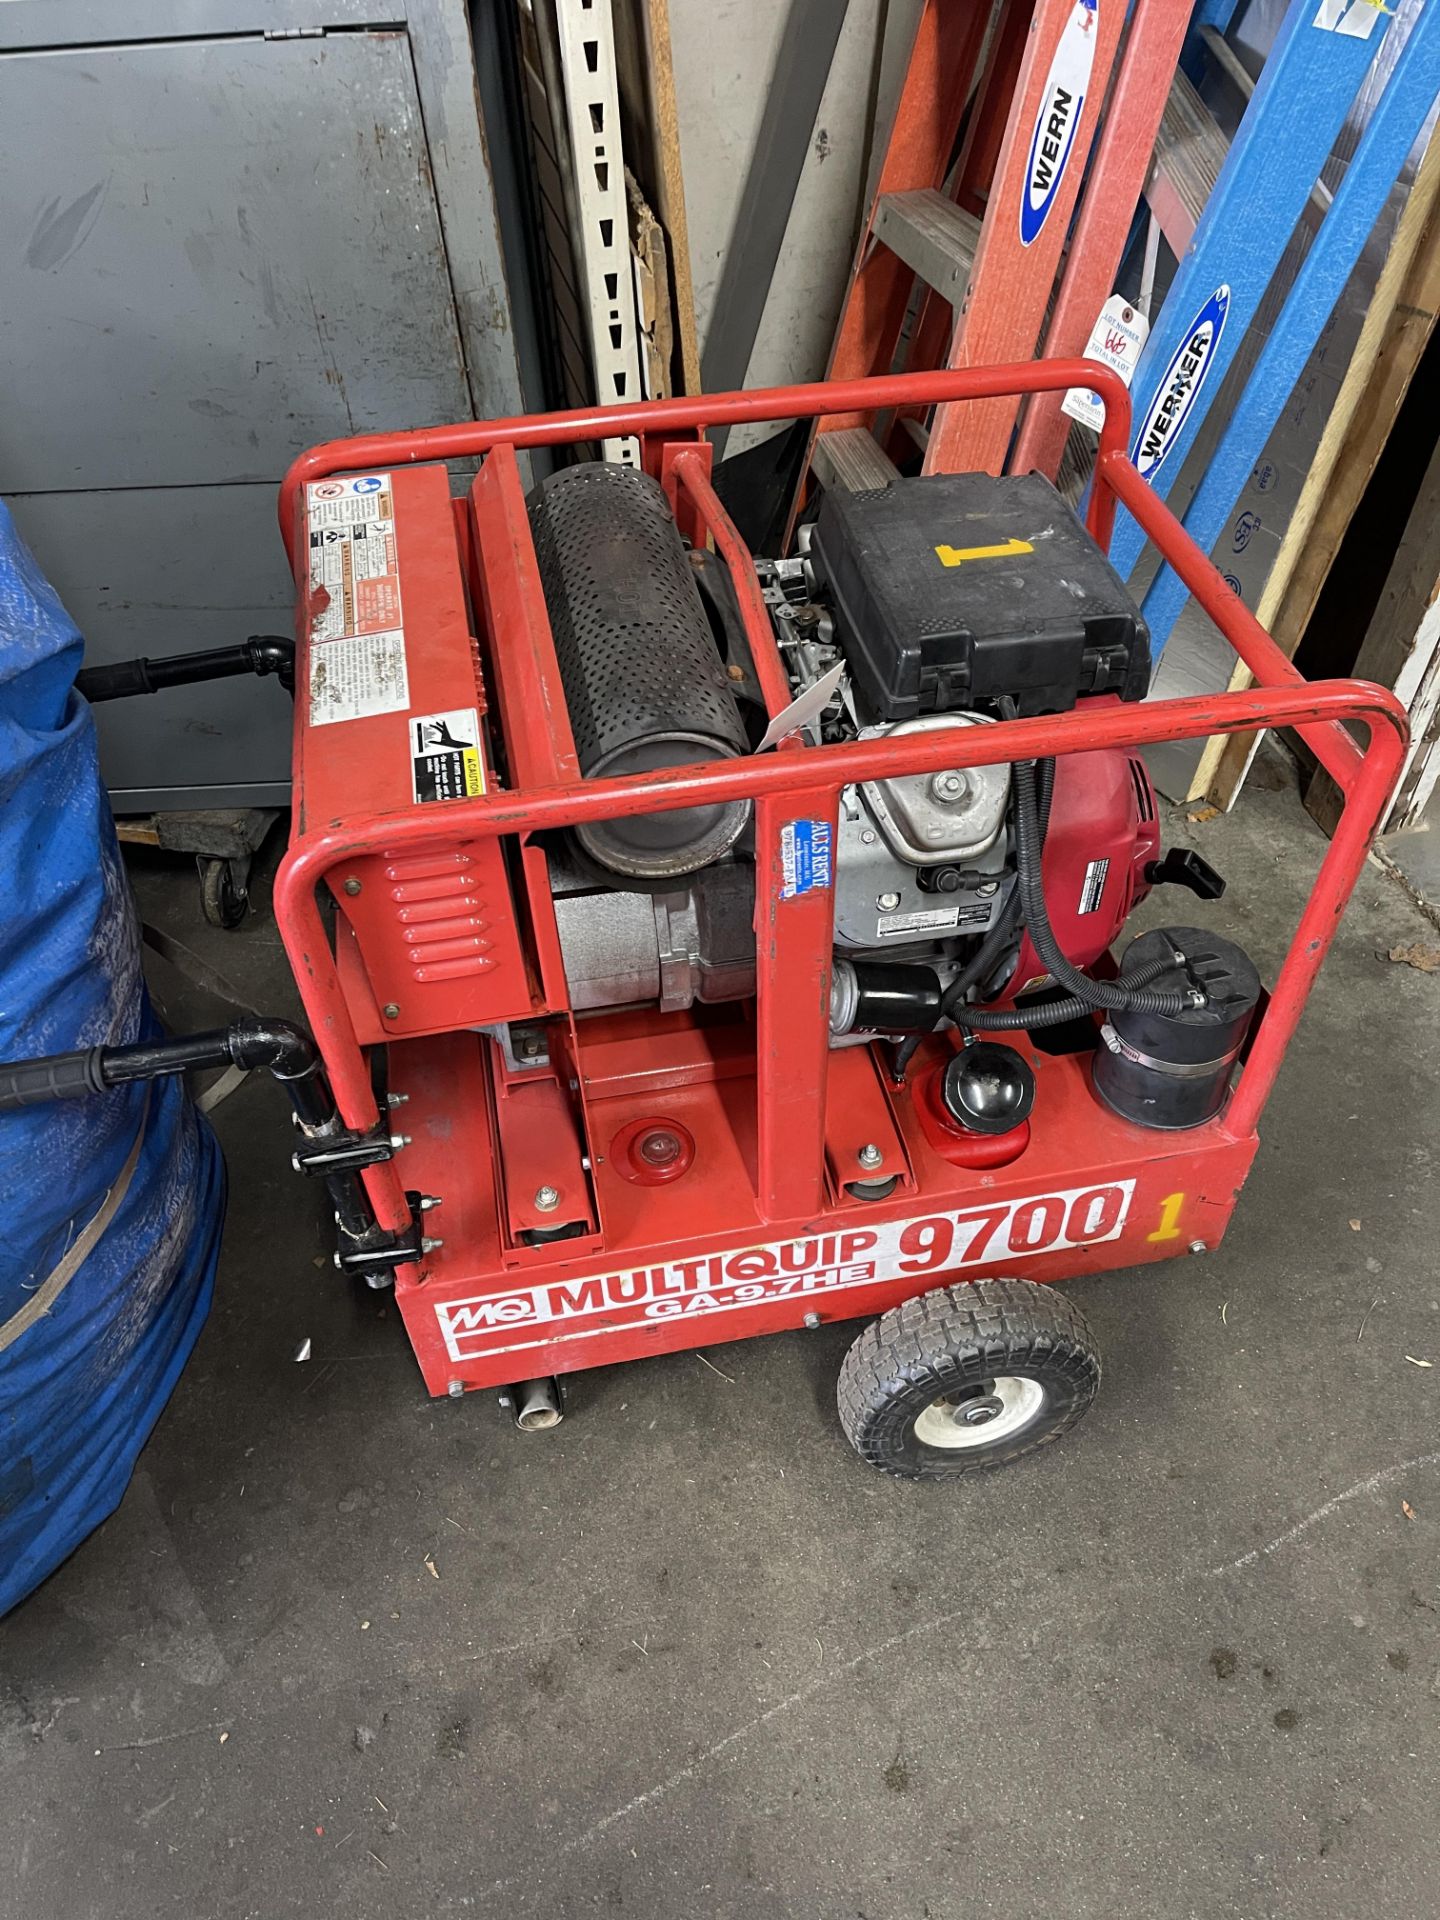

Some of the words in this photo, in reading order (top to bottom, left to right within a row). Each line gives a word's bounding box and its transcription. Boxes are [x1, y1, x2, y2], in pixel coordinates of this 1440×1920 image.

[1032, 87, 1073, 191] WERN
[1104, 314, 1116, 325] LOT
[1115, 322, 1141, 342] NUMBER
[1090, 343, 1110, 359] TOTAL
[1109, 356, 1117, 364] IN
[1117, 362, 1130, 373] LOT
[469, 764, 479, 795] CAUTION
[897, 1185, 1127, 1273] 9700
[1146, 1192, 1188, 1243] 1
[549, 1230, 878, 1317] MULTIQUIP
[644, 1261, 873, 1319] GA-9.7HE
